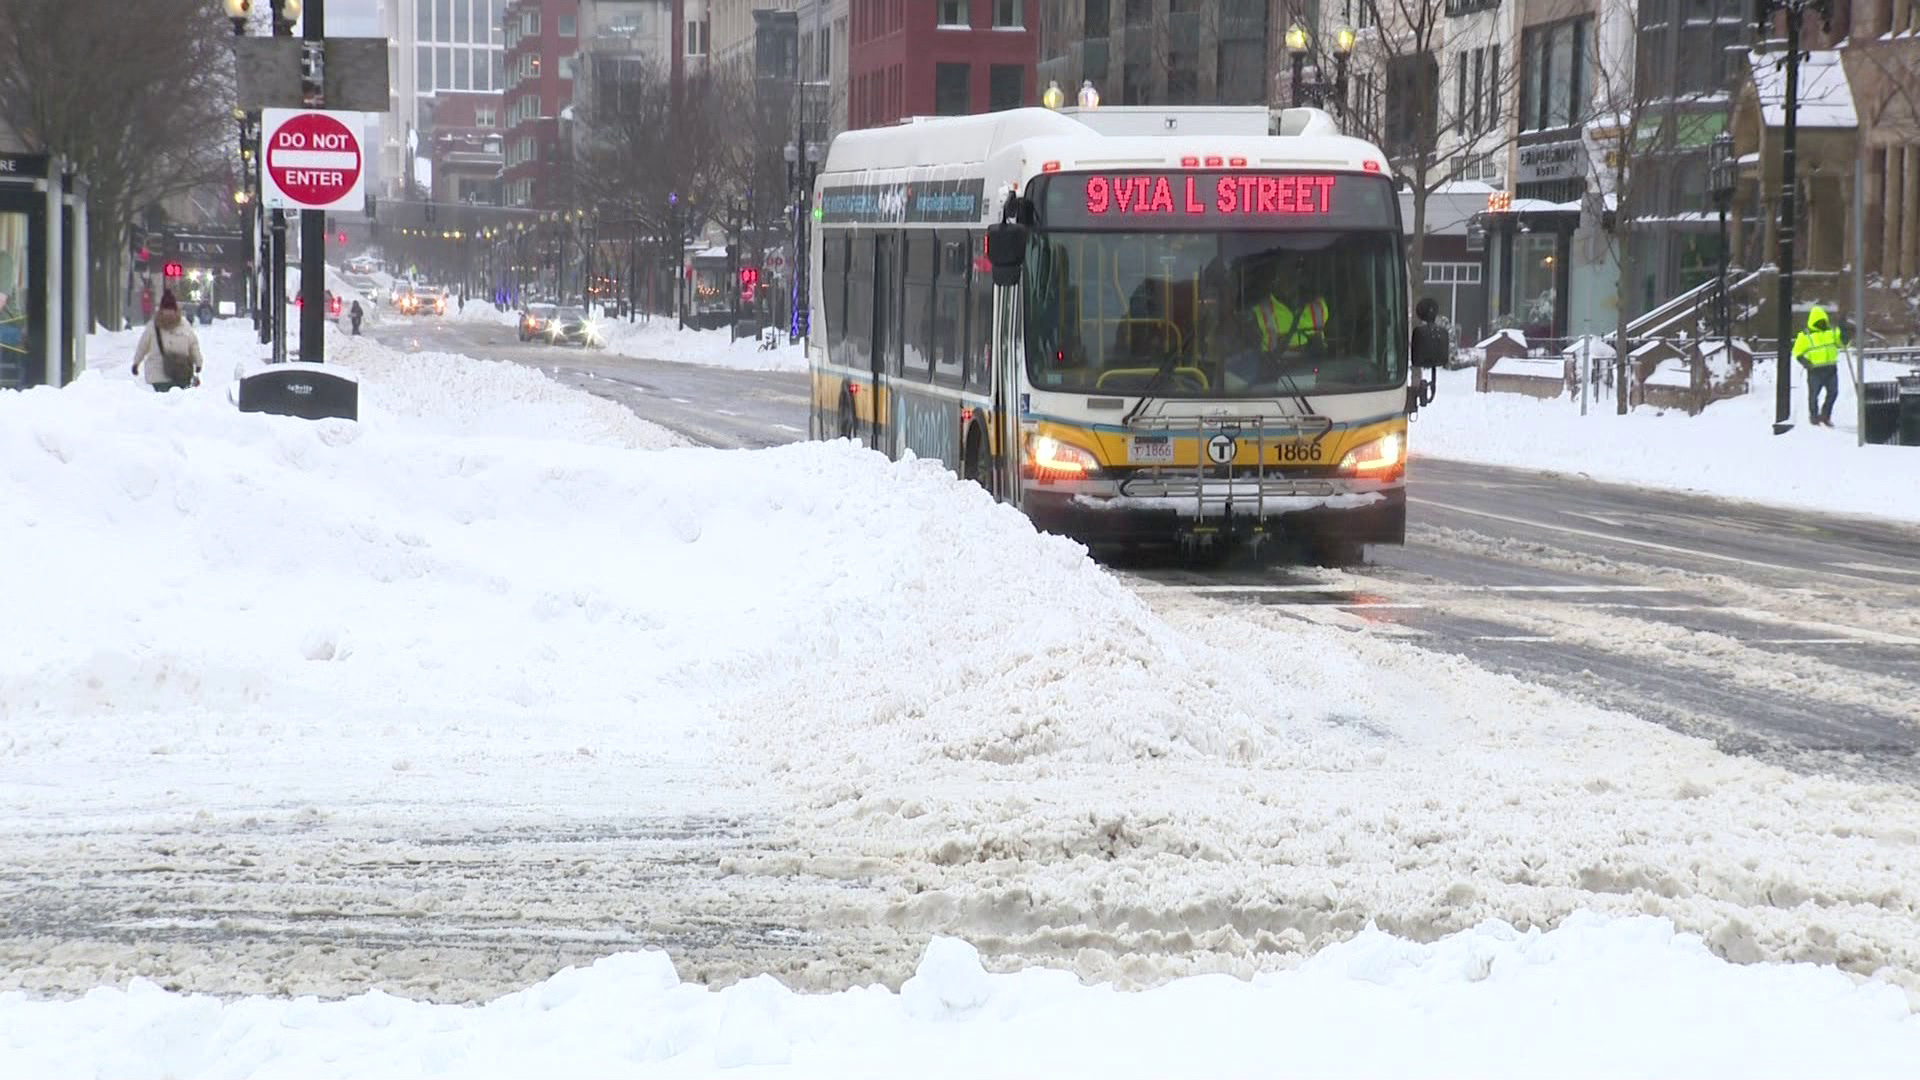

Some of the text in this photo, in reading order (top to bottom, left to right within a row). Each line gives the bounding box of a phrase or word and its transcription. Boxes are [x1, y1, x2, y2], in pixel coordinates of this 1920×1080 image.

[279, 132, 349, 150] DO NOT
[285, 170, 344, 187] ENTER
[1185, 176, 1206, 213] L
[1217, 176, 1336, 213] STREET
[179, 242, 224, 254] LENX
[1145, 444, 1172, 457] 1866
[1273, 443, 1322, 462] 1866
